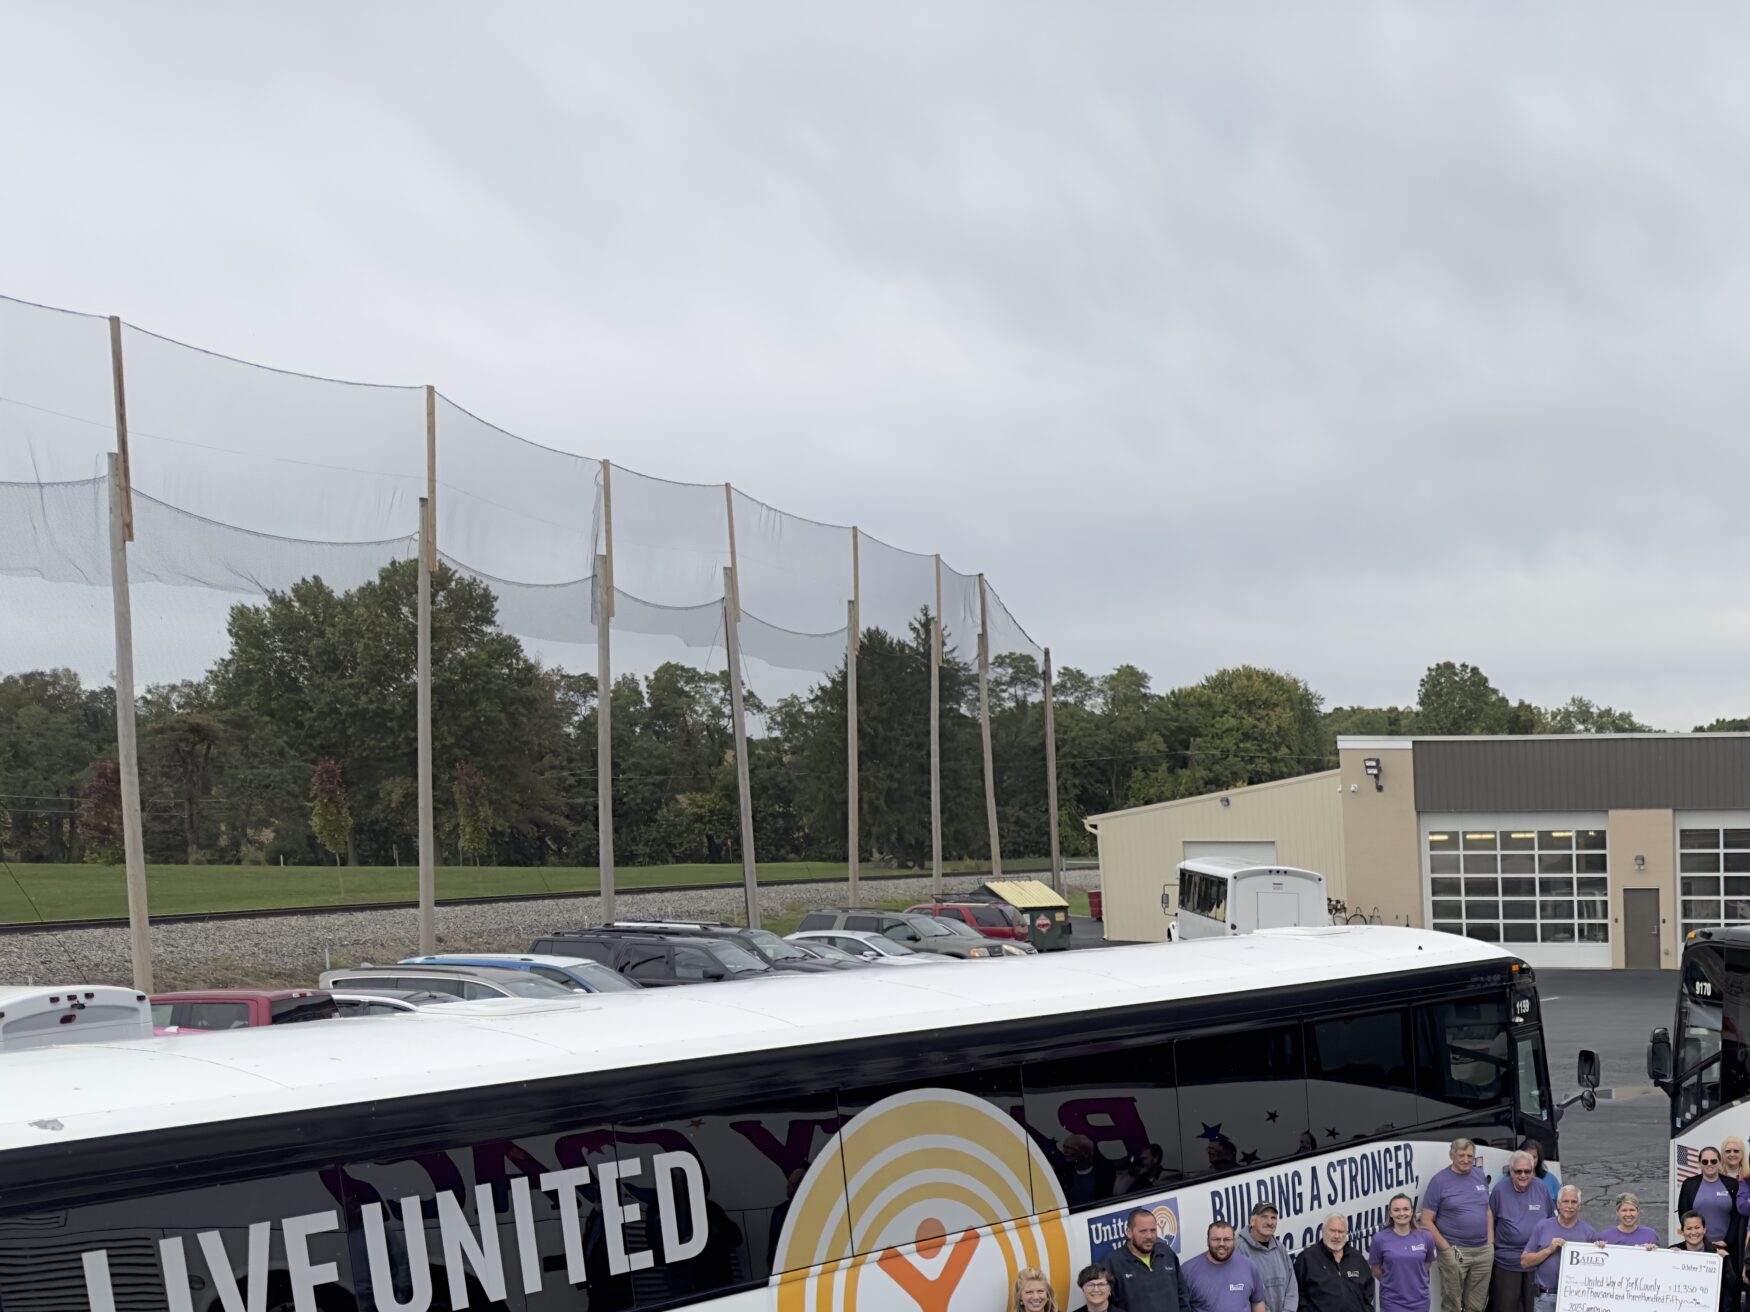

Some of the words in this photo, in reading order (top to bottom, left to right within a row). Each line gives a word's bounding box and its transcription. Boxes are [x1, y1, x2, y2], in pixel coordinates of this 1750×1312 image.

[1695, 981, 1712, 996] 9170
[1515, 999, 1529, 1015] 1159
[1309, 1165, 1322, 1211] A
[1326, 1142, 1419, 1206] STRONGER,
[1091, 1218, 1128, 1244] Unite
[1569, 1250, 1606, 1266] BAILEY
[1584, 1276, 1604, 1287] United
[1606, 1276, 1615, 1293] Way
[1639, 1277, 1660, 1295] County
[1564, 1286, 1586, 1297] Eleven
[1586, 1287, 1614, 1300] Thousand
[1665, 1295, 1682, 1311] Fifty
